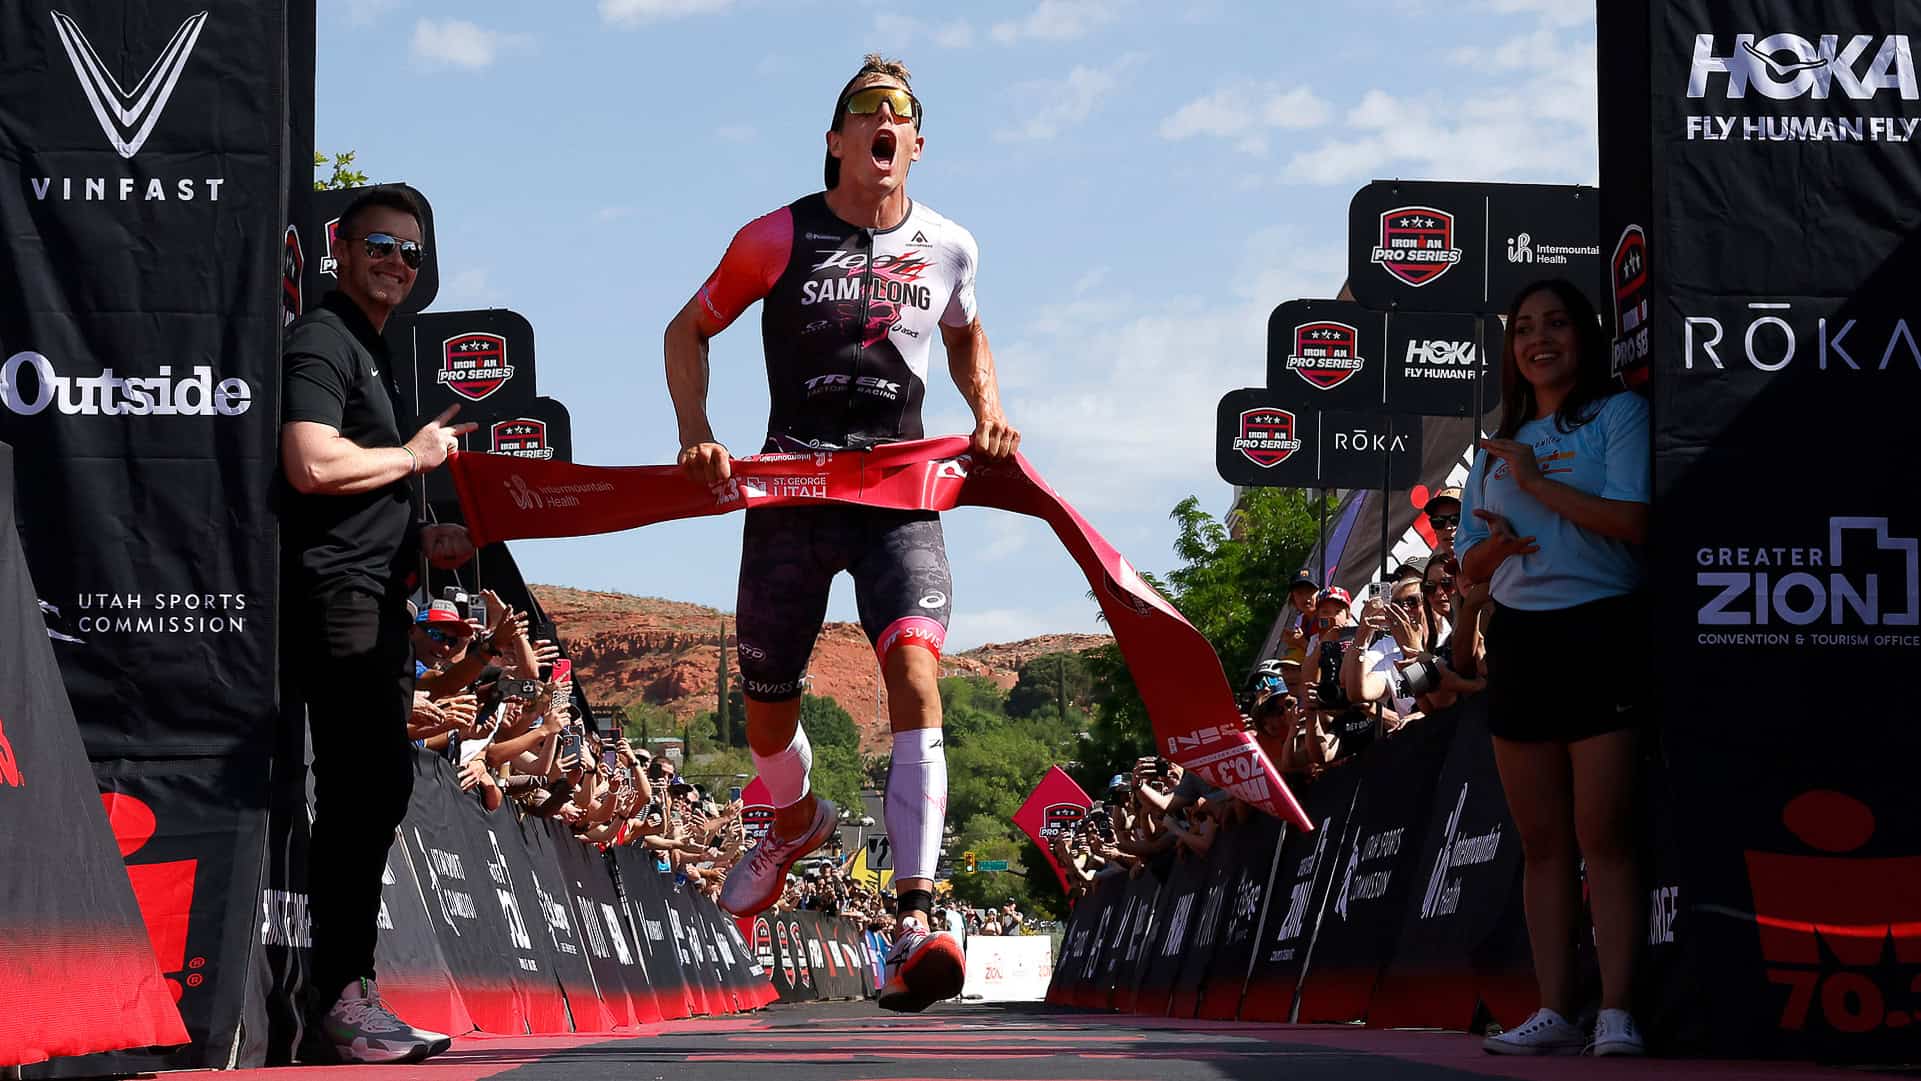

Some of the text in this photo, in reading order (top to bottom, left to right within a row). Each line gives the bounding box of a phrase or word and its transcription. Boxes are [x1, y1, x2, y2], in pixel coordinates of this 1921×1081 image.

[1687, 33, 1920, 100] HOKA
[1687, 116, 1920, 142] FLY HUMAN FLY
[31, 177, 224, 201] VINFAST
[1375, 250, 1458, 262] PRO SERIES
[1537, 244, 1600, 256] Intermountai
[1537, 254, 1567, 265] Health
[801, 277, 931, 311] SAM LONG
[1289, 357, 1362, 369] PRO SERIES
[440, 368, 512, 382] PRO SERIES
[1405, 367, 1423, 378] FLY
[1424, 368, 1466, 380] HUMAN
[0, 351, 252, 416] Outside
[804, 374, 902, 394] TREK
[1236, 440, 1300, 450] PRO SERIES
[788, 477, 826, 485] GEORGE
[547, 495, 580, 509] Health
[1697, 548, 1823, 566] GREATER
[79, 593, 246, 610] UTAH SPORTS
[1697, 572, 1879, 625] ZION
[79, 616, 244, 633] COMMISSION
[1697, 633, 1921, 647] CONVENTION & TOURISM OFFICE
[1217, 752, 1265, 786] 70.3
[1041, 828, 1059, 836] PRO
